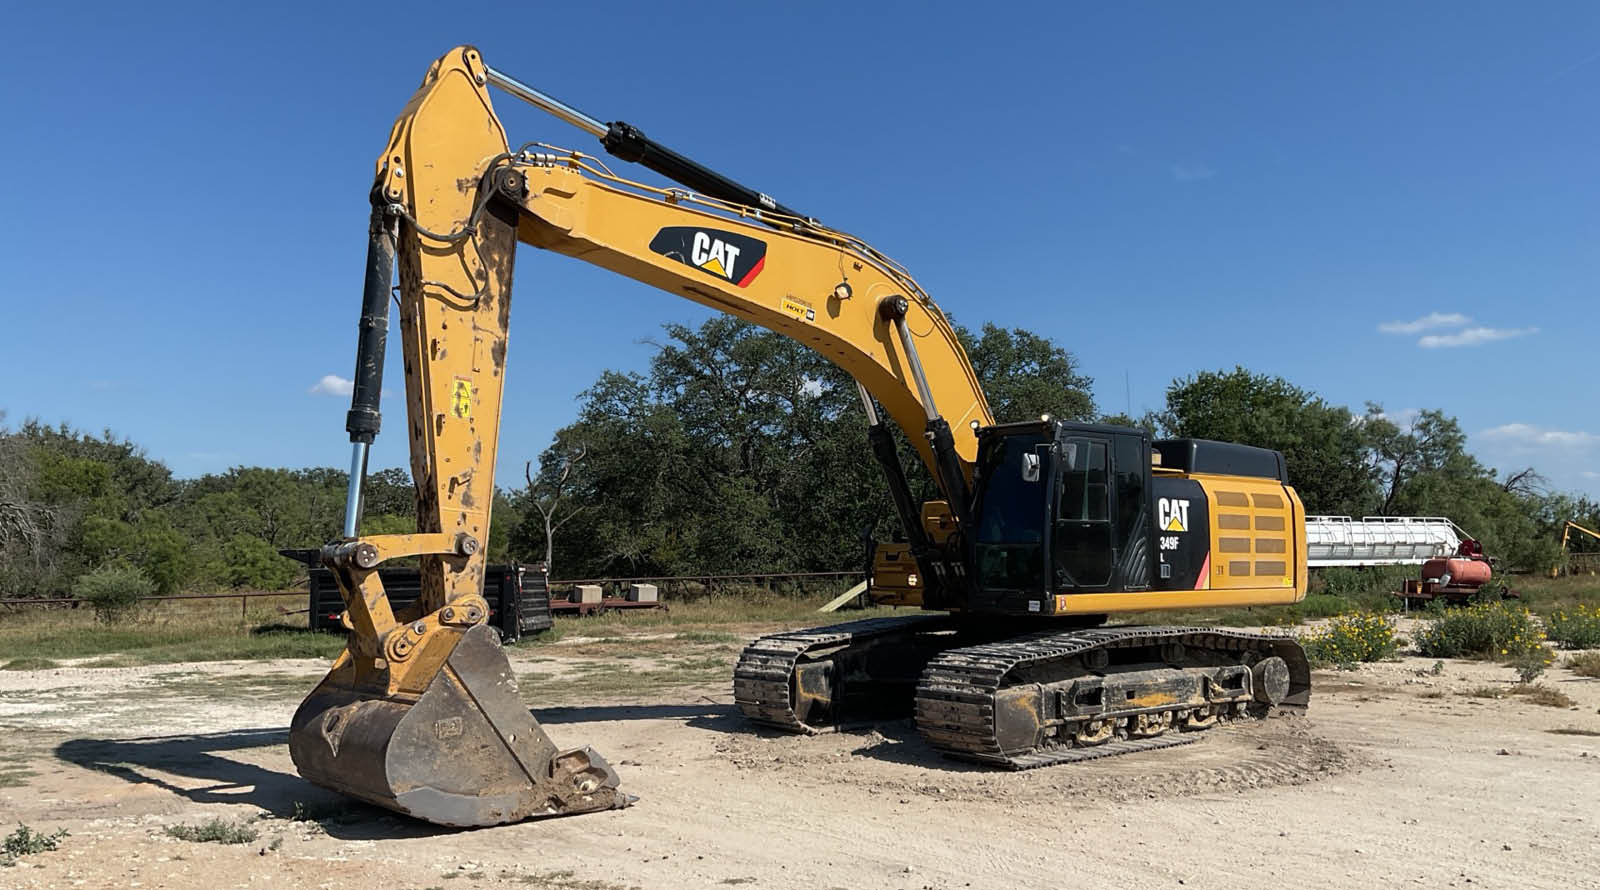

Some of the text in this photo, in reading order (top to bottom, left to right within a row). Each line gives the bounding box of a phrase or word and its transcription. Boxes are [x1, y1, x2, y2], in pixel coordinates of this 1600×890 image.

[691, 231, 740, 279] CAT
[1158, 498, 1190, 532] CAT
[1160, 536, 1179, 550] 349F
[1160, 552, 1165, 562] L
